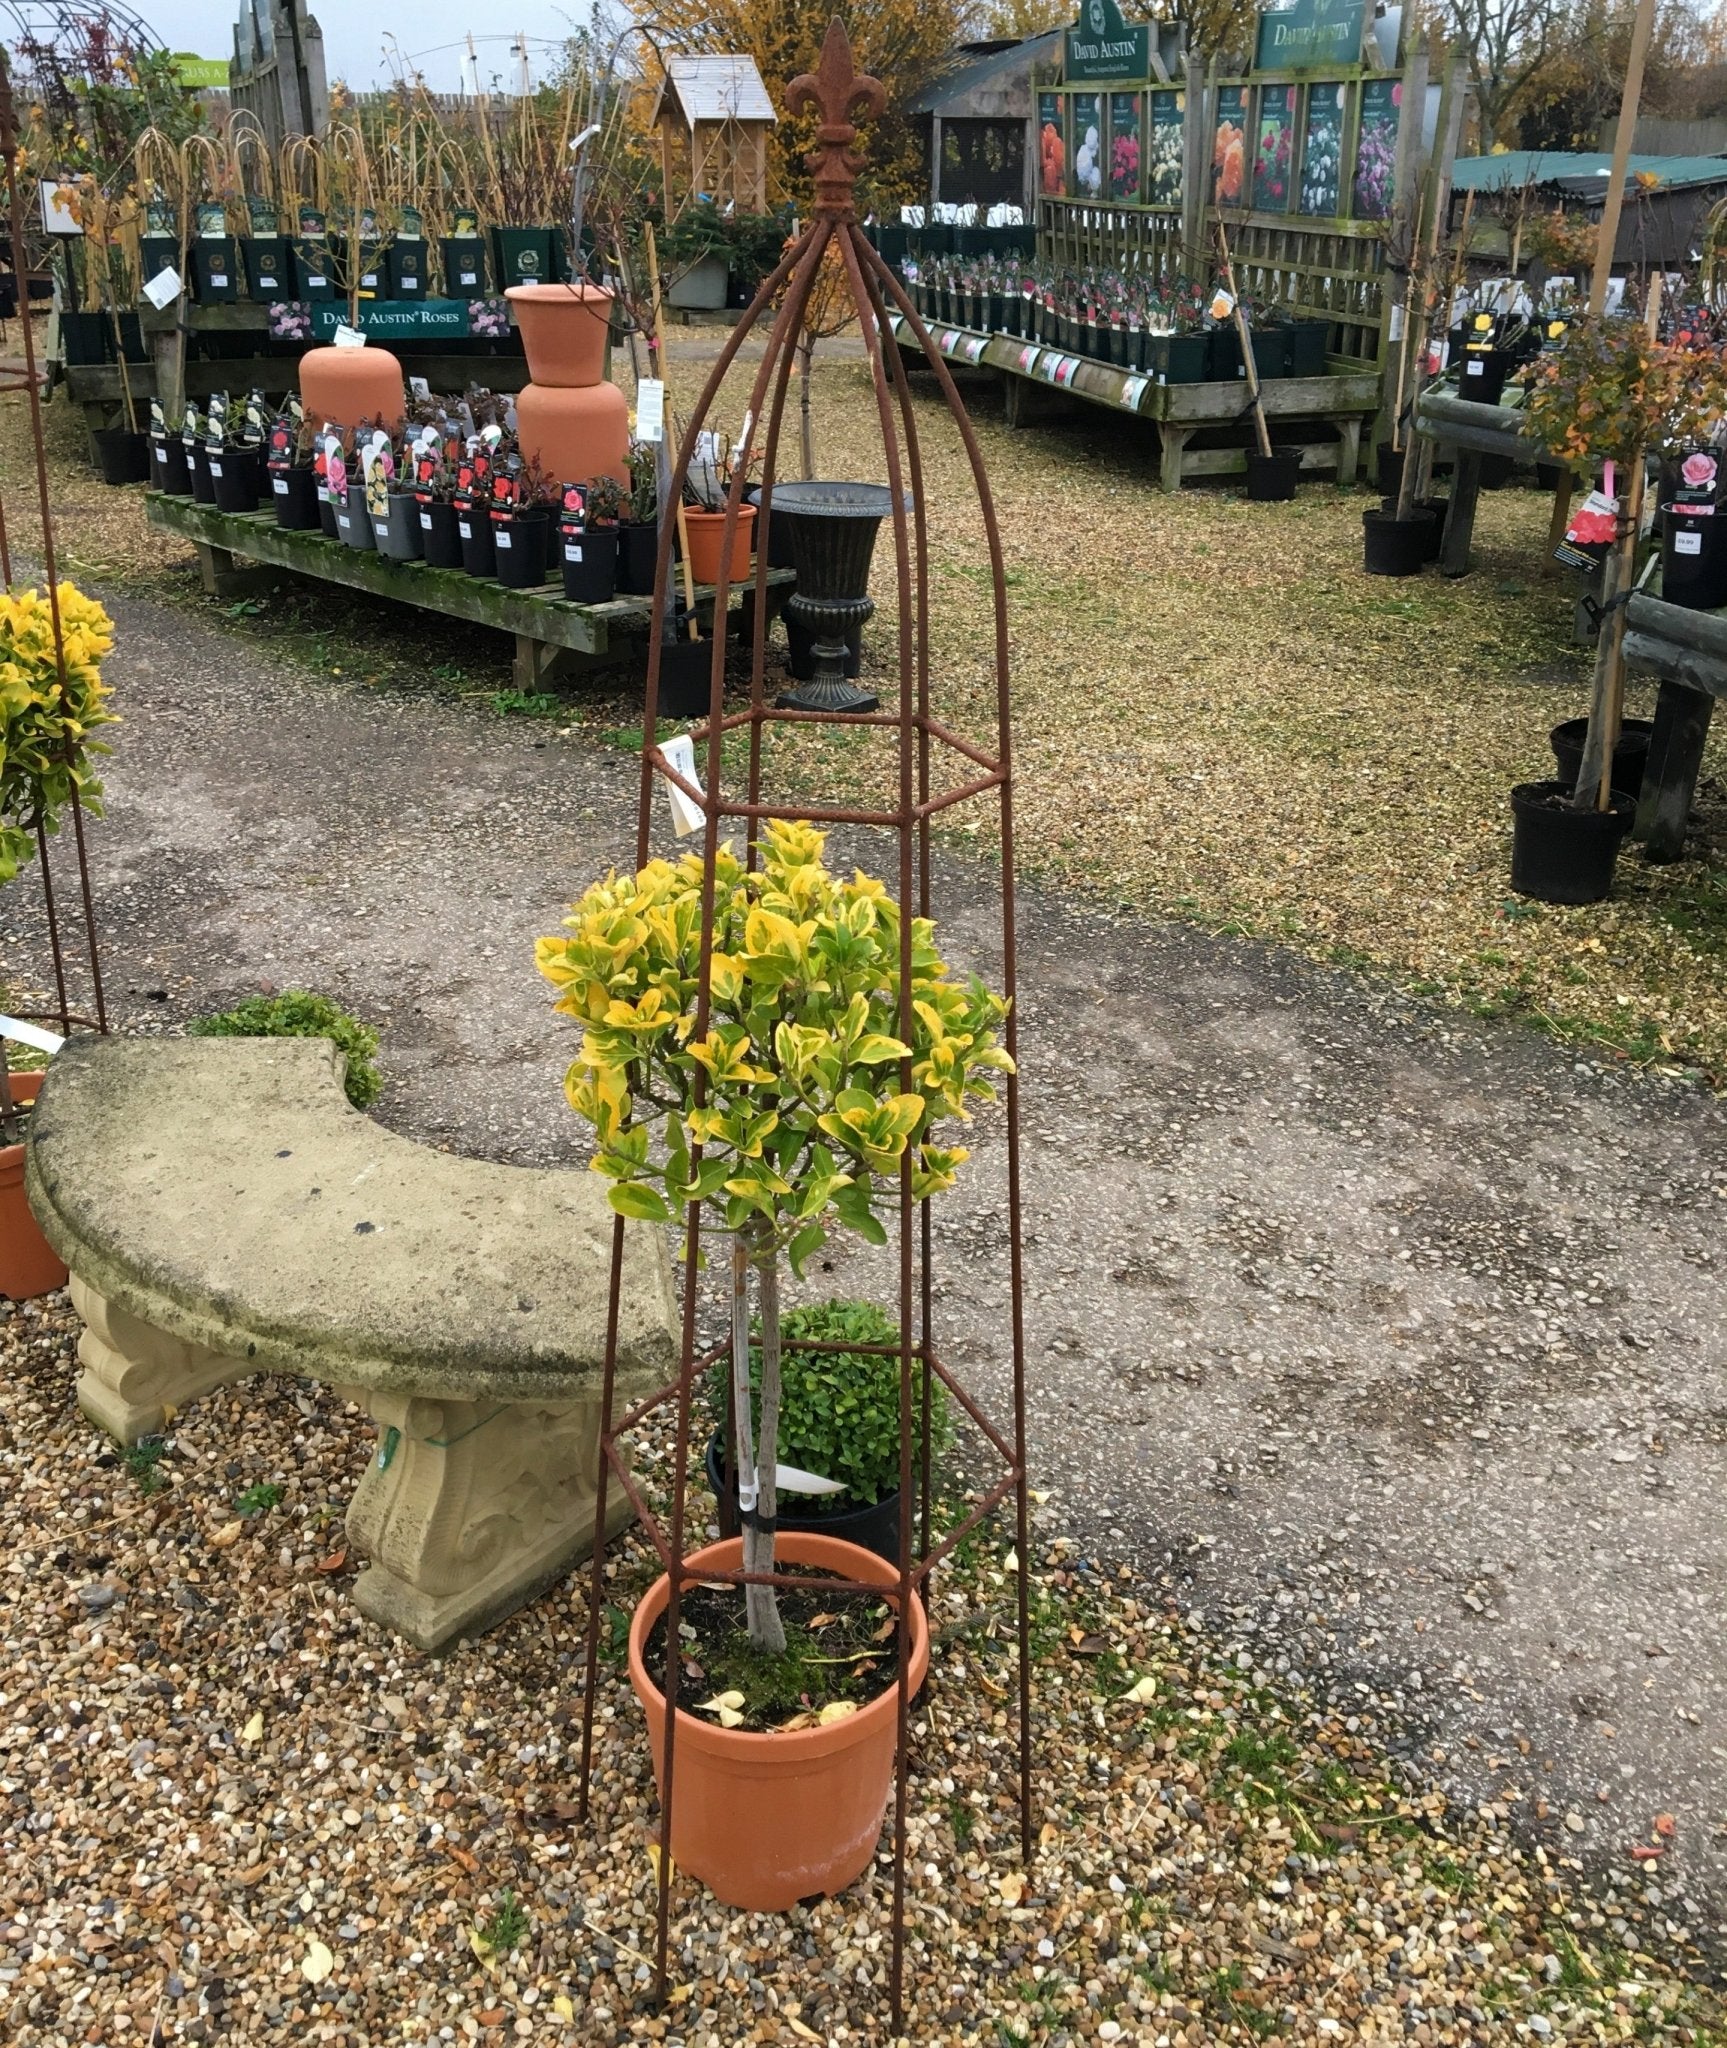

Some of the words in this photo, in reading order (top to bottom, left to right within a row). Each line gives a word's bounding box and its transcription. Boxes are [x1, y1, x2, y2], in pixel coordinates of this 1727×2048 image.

[1073, 41, 1099, 60] DAVID
[1101, 40, 1136, 58] AUSTIN
[323, 312, 365, 325] DAVD
[421, 311, 460, 324] ROSES
